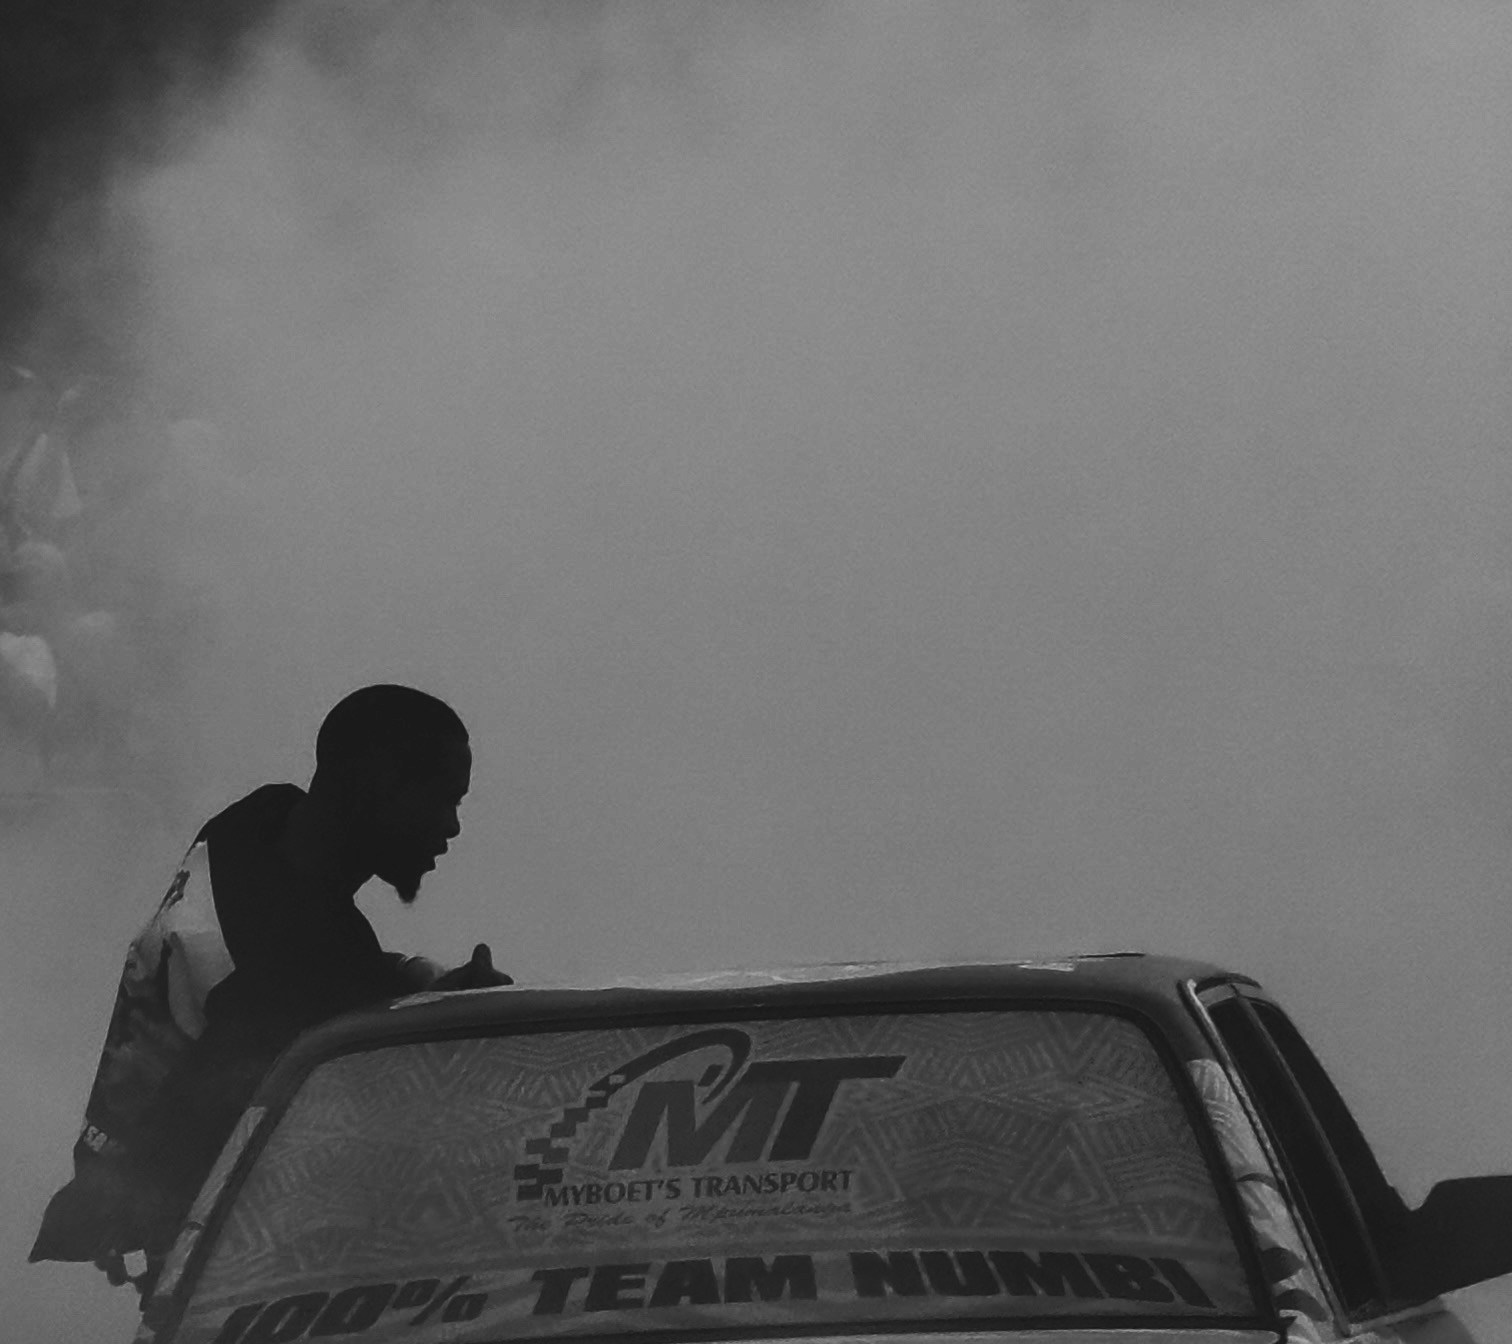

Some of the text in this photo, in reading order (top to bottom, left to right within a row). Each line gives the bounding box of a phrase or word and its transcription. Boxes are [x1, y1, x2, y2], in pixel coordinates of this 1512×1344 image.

[542, 1168, 855, 1206] MYBOET'S TRANSPORT
[531, 1254, 818, 1315] TEAM
[847, 1250, 1215, 1308] NUMBI
